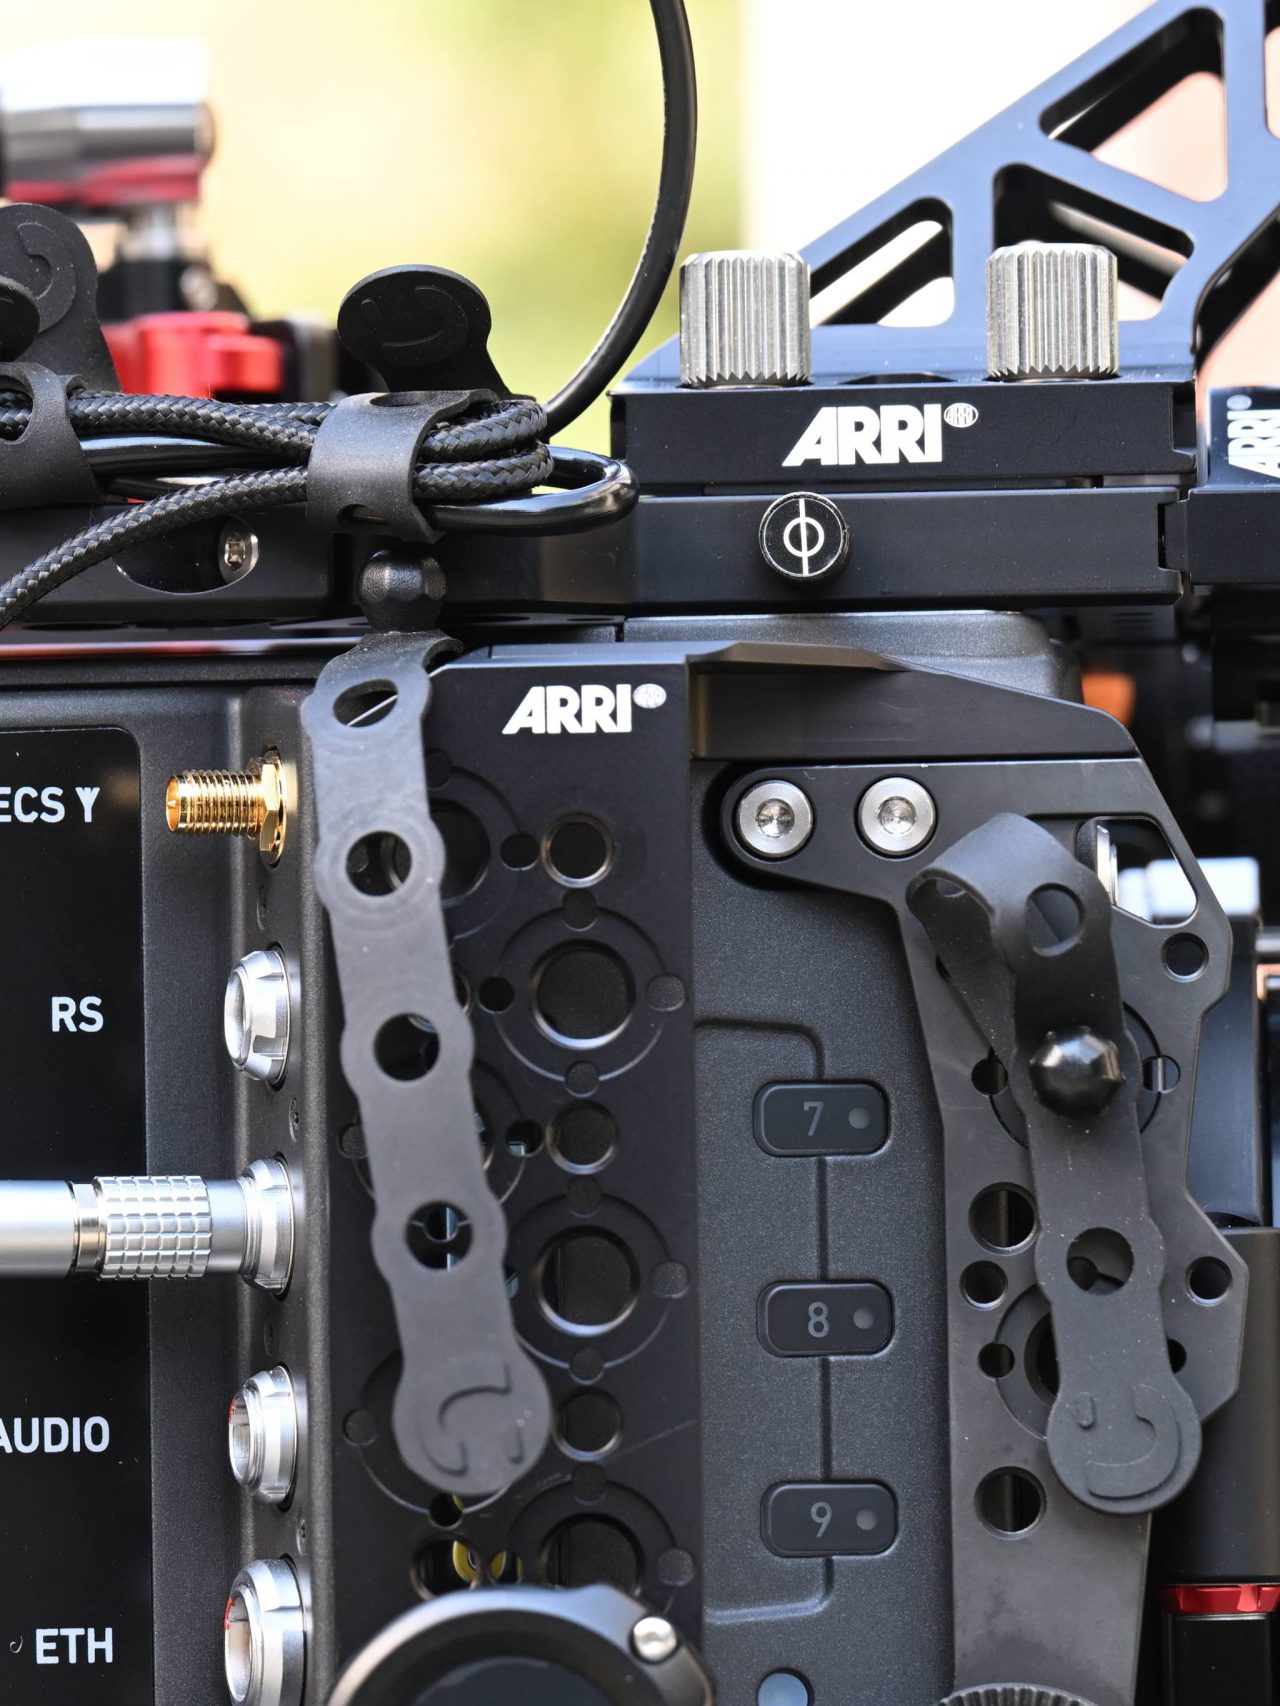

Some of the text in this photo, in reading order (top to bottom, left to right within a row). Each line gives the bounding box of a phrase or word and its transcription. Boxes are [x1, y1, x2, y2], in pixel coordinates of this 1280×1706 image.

[782, 403, 943, 467] ARRI
[501, 684, 632, 735] ARRI
[51, 996, 104, 1033] RS
[803, 1100, 824, 1137] 7
[807, 1301, 830, 1339] 8
[810, 1501, 833, 1539] 9
[35, 1627, 113, 1665] ETH
